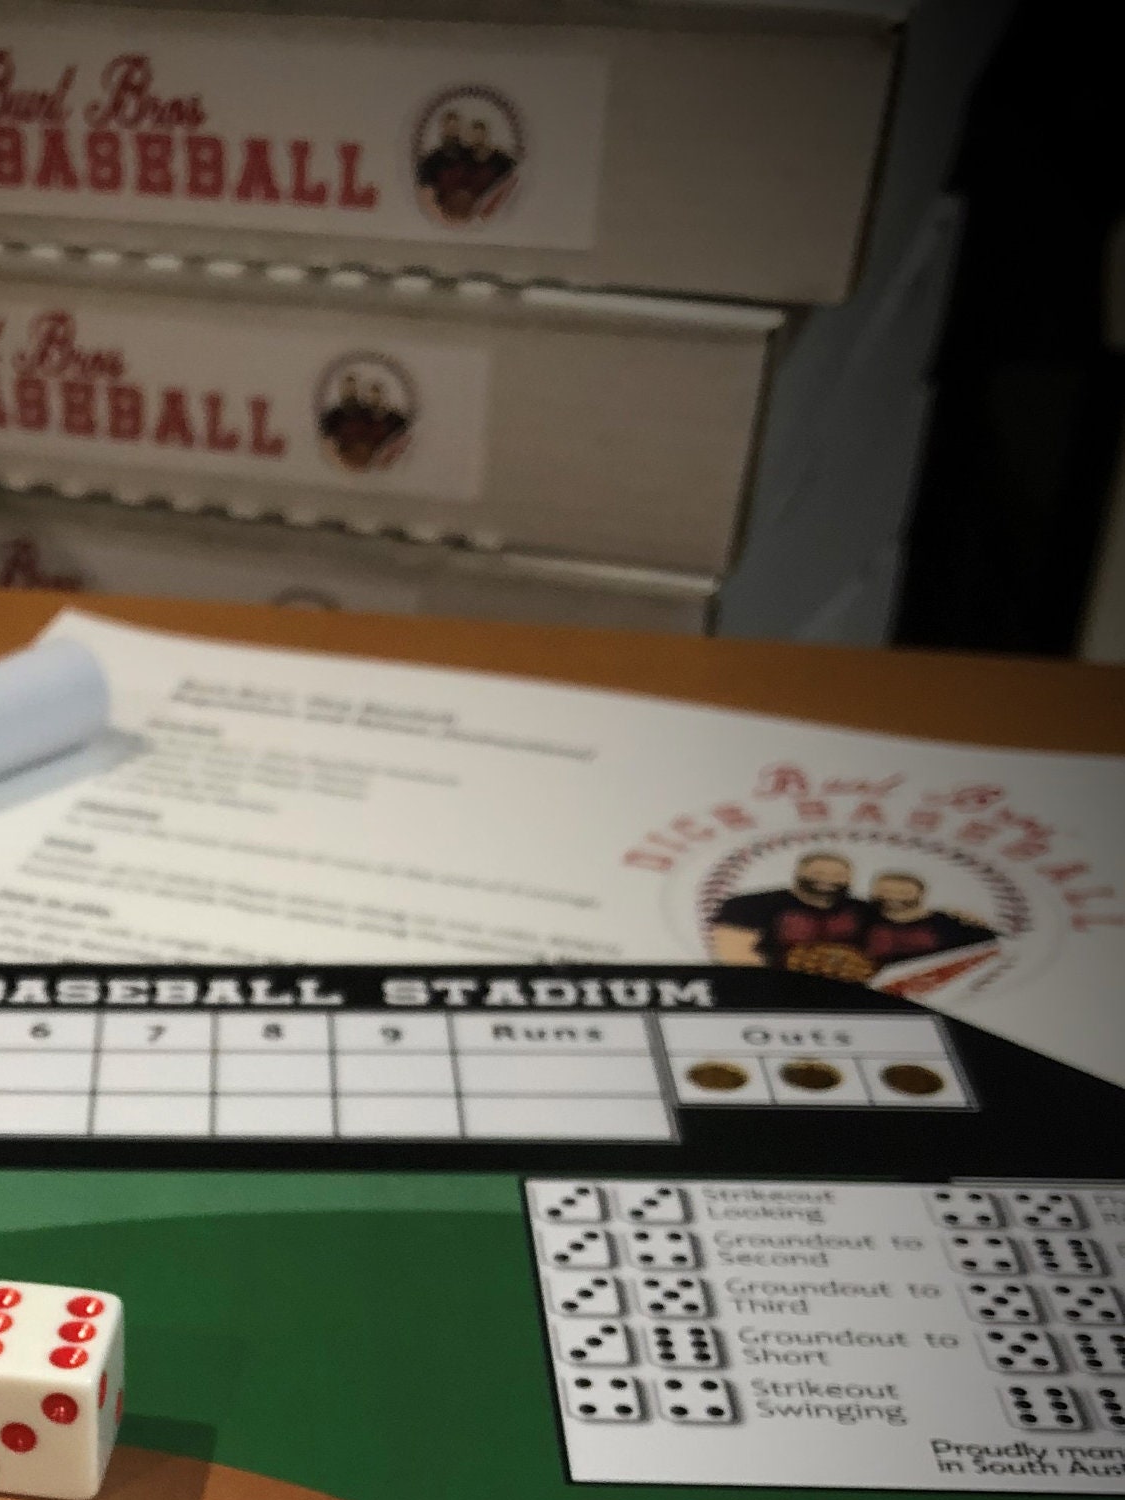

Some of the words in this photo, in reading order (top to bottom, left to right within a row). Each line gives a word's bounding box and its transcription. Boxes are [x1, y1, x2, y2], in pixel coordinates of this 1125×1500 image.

[83, 53, 208, 130] Bros
[380, 977, 714, 1008] STADIUM
[28, 1021, 52, 1041] 6
[147, 1023, 167, 1043] 7
[261, 1021, 284, 1041] 8
[380, 1024, 403, 1044] 9
[490, 1021, 605, 1044] Runs
[740, 1023, 854, 1048] Outs
[701, 1185, 837, 1204] Strikeout
[706, 1205, 826, 1224] Looking
[714, 1229, 876, 1251] Groundout
[890, 1234, 925, 1252] to
[717, 1249, 830, 1268] Second
[725, 1277, 892, 1299] Groundout
[906, 1282, 942, 1299] to
[734, 1297, 811, 1316] Third
[738, 1325, 909, 1348] Groundout
[924, 1331, 961, 1349] to
[741, 1345, 832, 1368] Short
[749, 1376, 900, 1400] Strikeout
[755, 1400, 910, 1427] Swinging
[929, 1436, 1049, 1465] Proudly
[937, 1458, 965, 1475] in
[972, 1456, 1061, 1477] South
